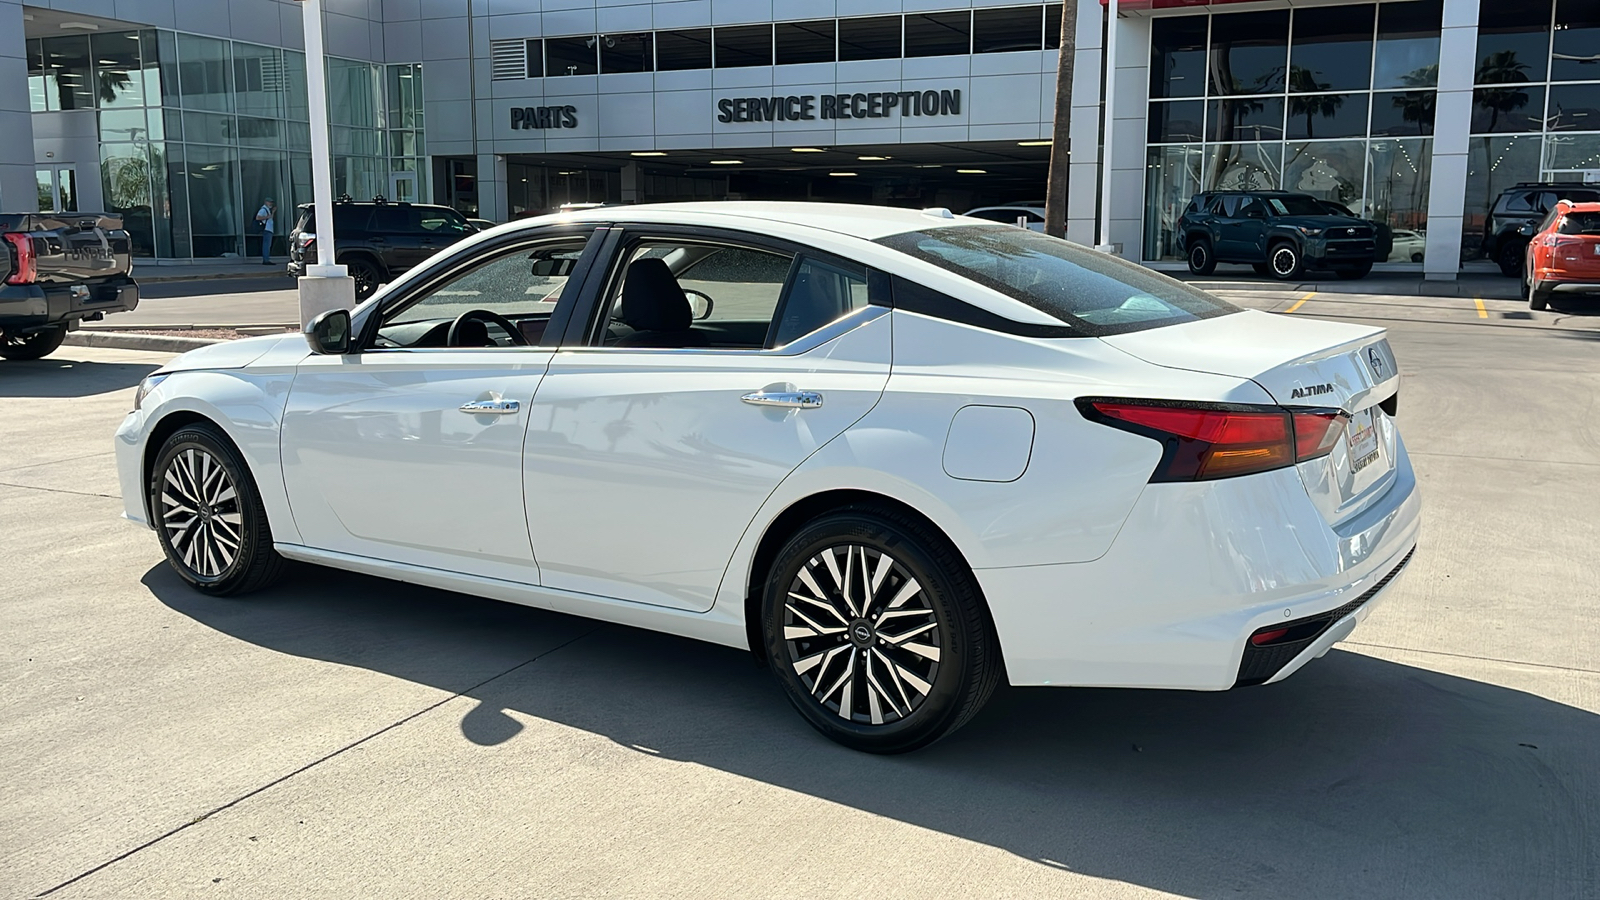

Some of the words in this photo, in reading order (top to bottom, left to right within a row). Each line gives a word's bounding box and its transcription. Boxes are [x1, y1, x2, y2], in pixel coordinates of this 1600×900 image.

[717, 95, 815, 123] SERVICE
[820, 89, 961, 119] RECEPTION
[510, 105, 577, 130] PARTS
[61, 247, 114, 261] TUNDRA
[1291, 383, 1334, 399] ALTIMA
